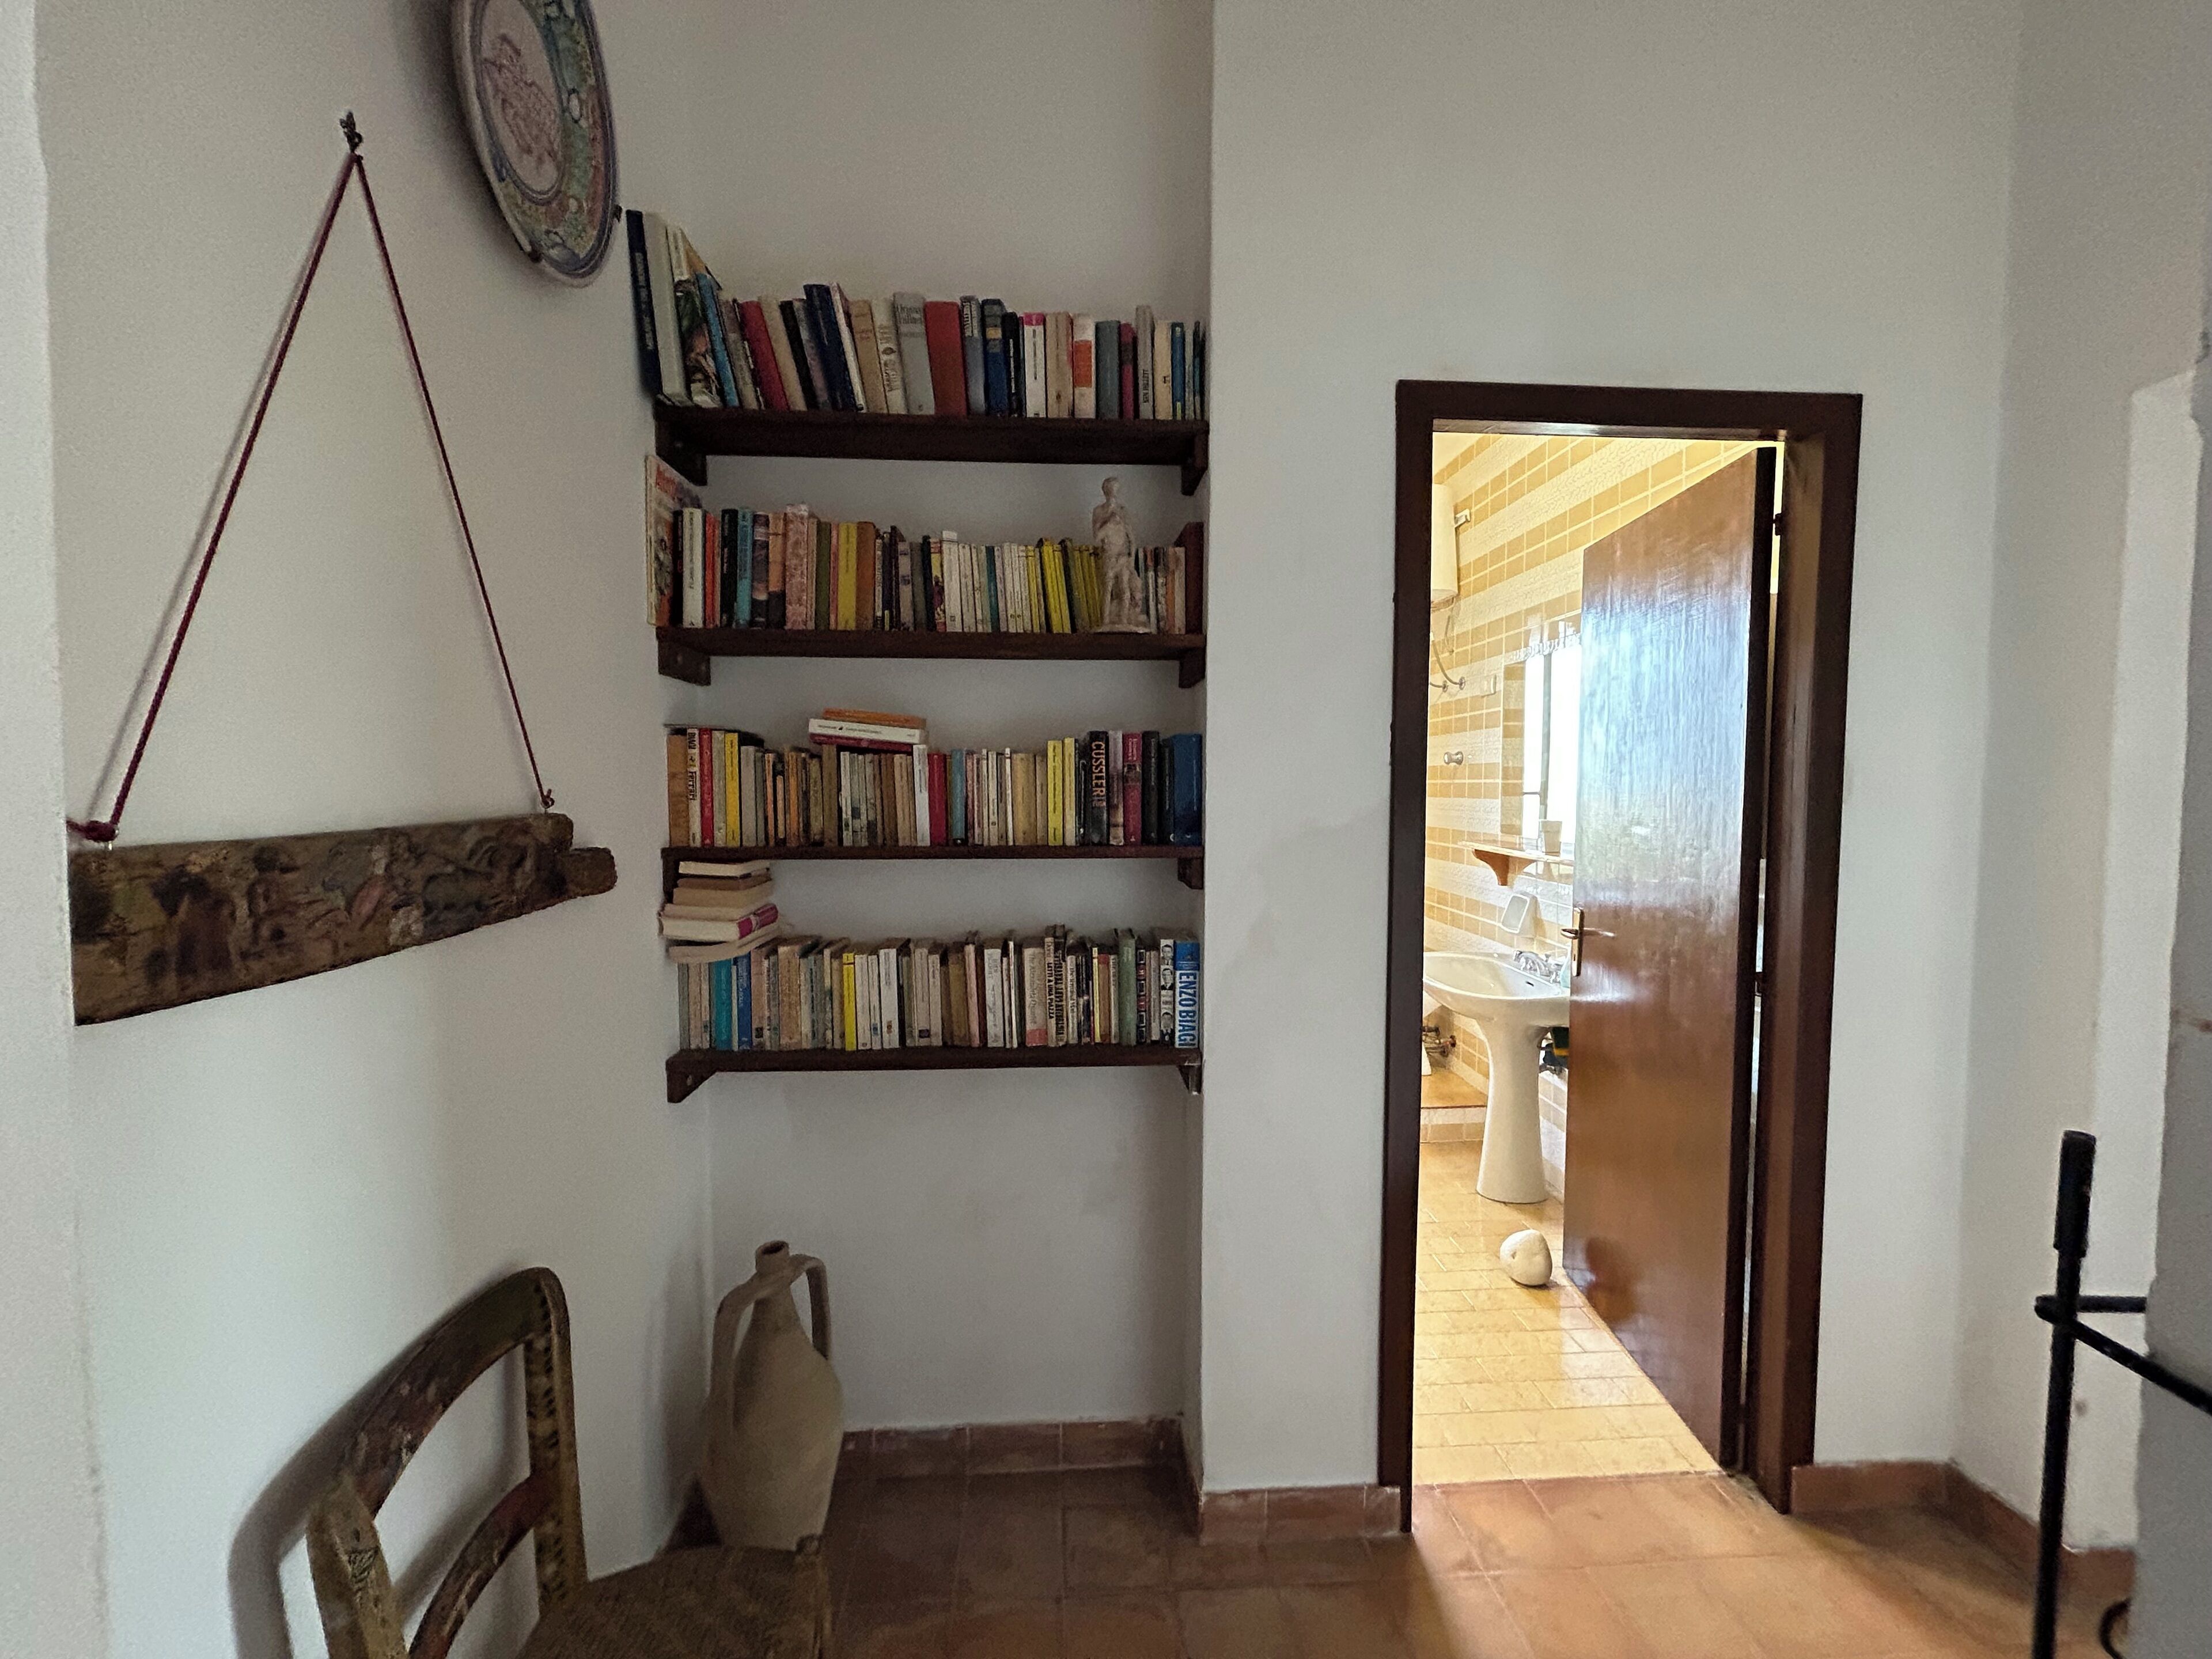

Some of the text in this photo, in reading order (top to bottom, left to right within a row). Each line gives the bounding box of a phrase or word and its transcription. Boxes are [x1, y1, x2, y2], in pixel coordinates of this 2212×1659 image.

[688, 771, 697, 801] Ferrari
[1092, 741, 1106, 796] CUSSLER
[1178, 972, 1198, 1047] ENZO BIAGI
